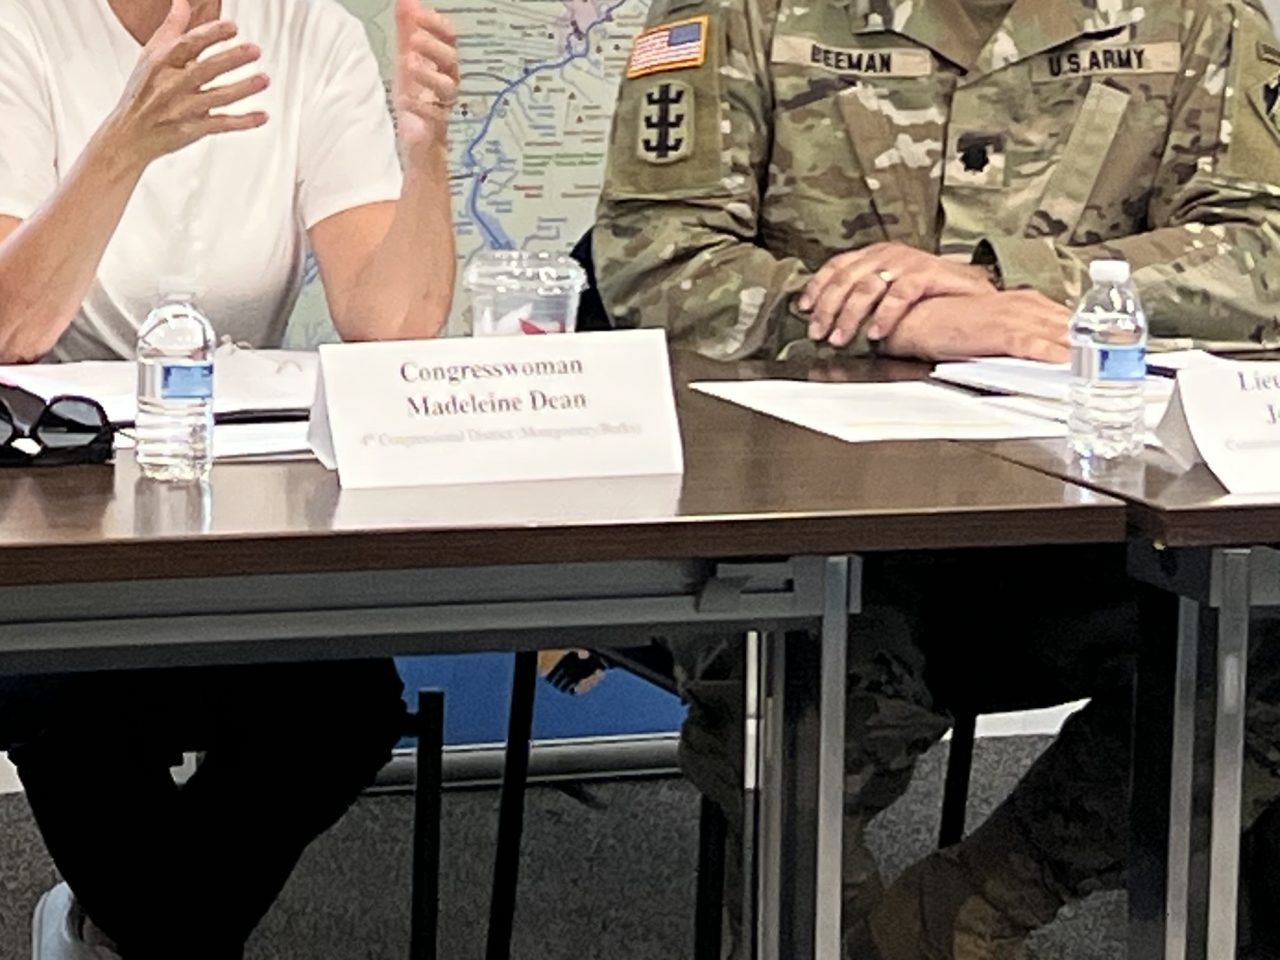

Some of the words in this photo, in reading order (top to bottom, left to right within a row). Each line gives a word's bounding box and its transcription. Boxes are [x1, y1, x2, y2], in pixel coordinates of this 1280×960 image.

[1089, 48, 1145, 70] ARMY
[400, 358, 584, 384] Congresswoman
[407, 392, 523, 417] Madeleine
[530, 390, 587, 411] Dean
